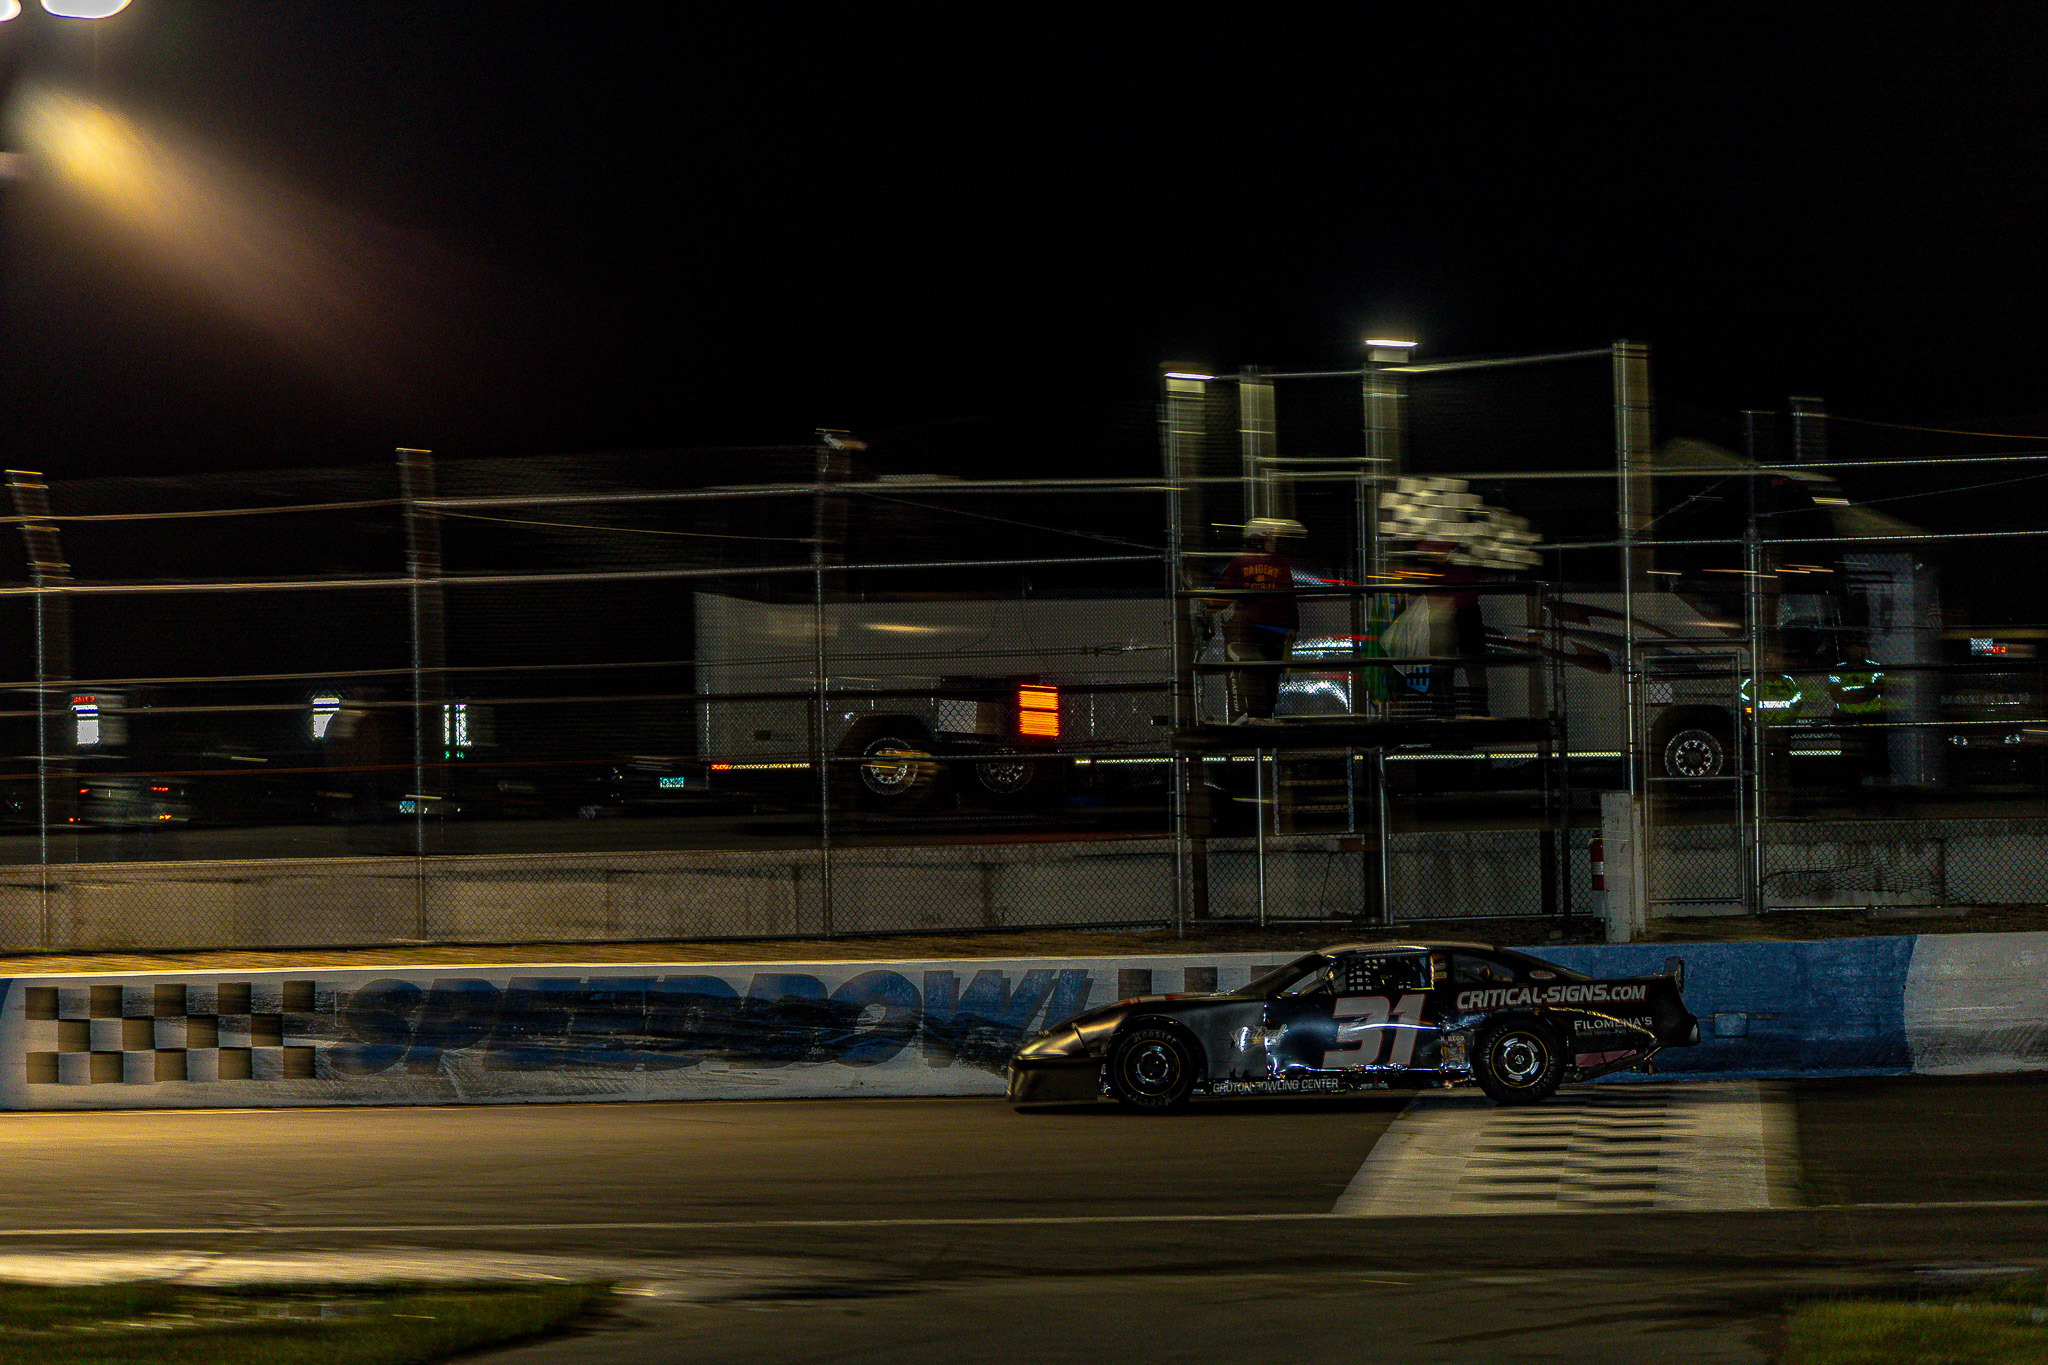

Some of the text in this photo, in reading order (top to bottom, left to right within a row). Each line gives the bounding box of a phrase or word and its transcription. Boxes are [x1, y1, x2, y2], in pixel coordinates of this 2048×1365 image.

[1243, 564, 1279, 578] RAIDERS
[1456, 983, 1648, 1010] CRITICAL-SIGNS.COM
[1322, 993, 1427, 1069] 31
[1573, 1016, 1653, 1031] FILOMENA'S
[1212, 1081, 1252, 1094] GROTON
[1301, 1077, 1339, 1090] CENTER
